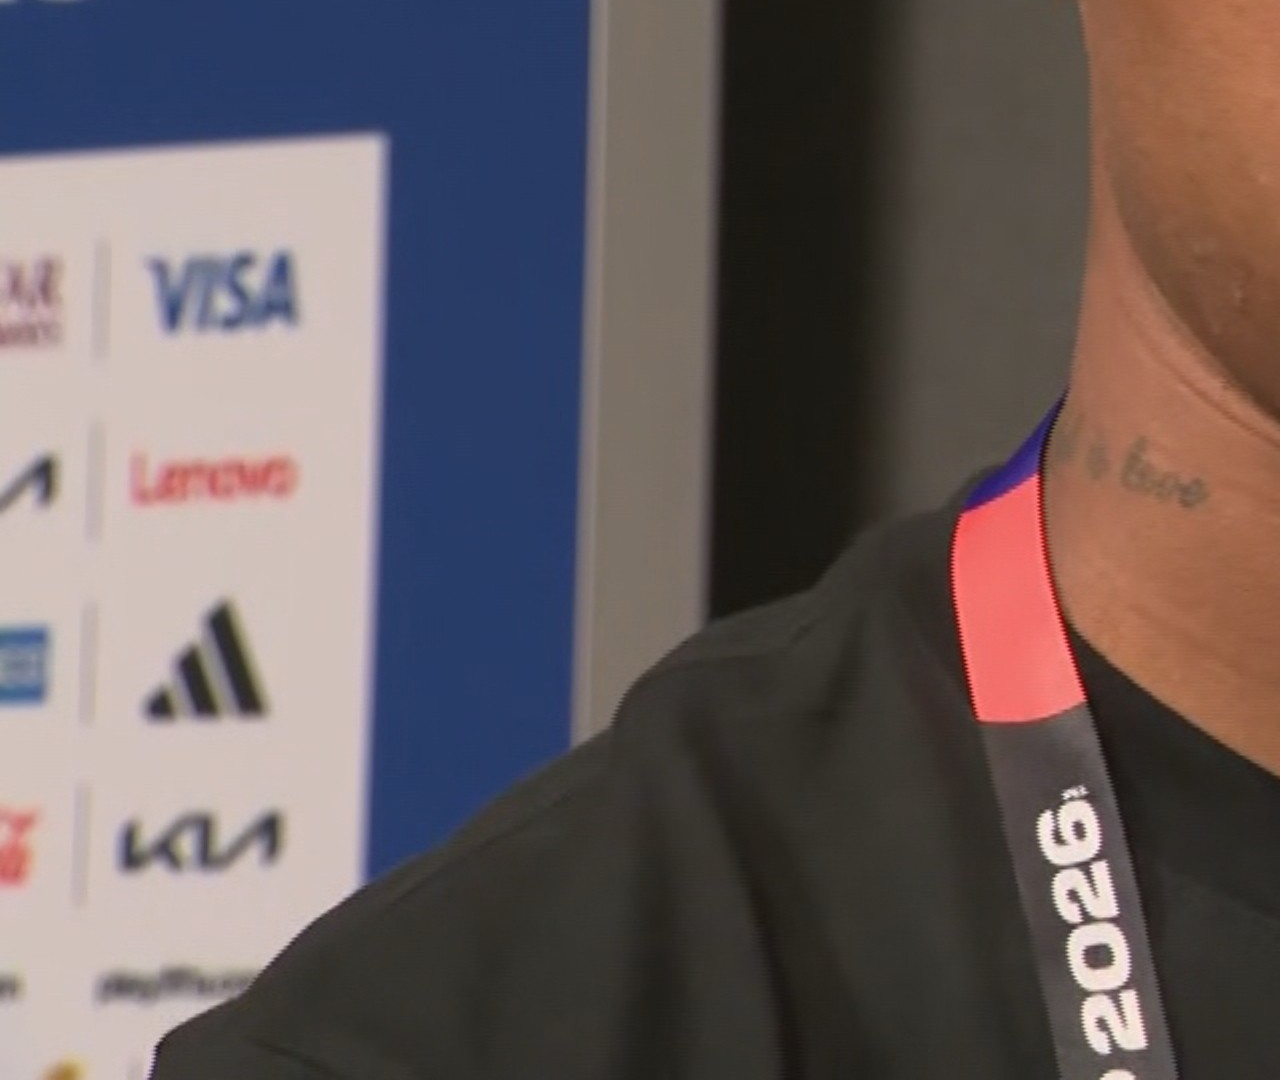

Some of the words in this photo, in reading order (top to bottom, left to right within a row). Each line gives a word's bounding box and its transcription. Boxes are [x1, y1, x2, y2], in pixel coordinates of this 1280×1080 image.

[148, 250, 300, 333] VISA
[130, 452, 296, 506] Lenovo
[1037, 799, 1148, 1055] 2026
